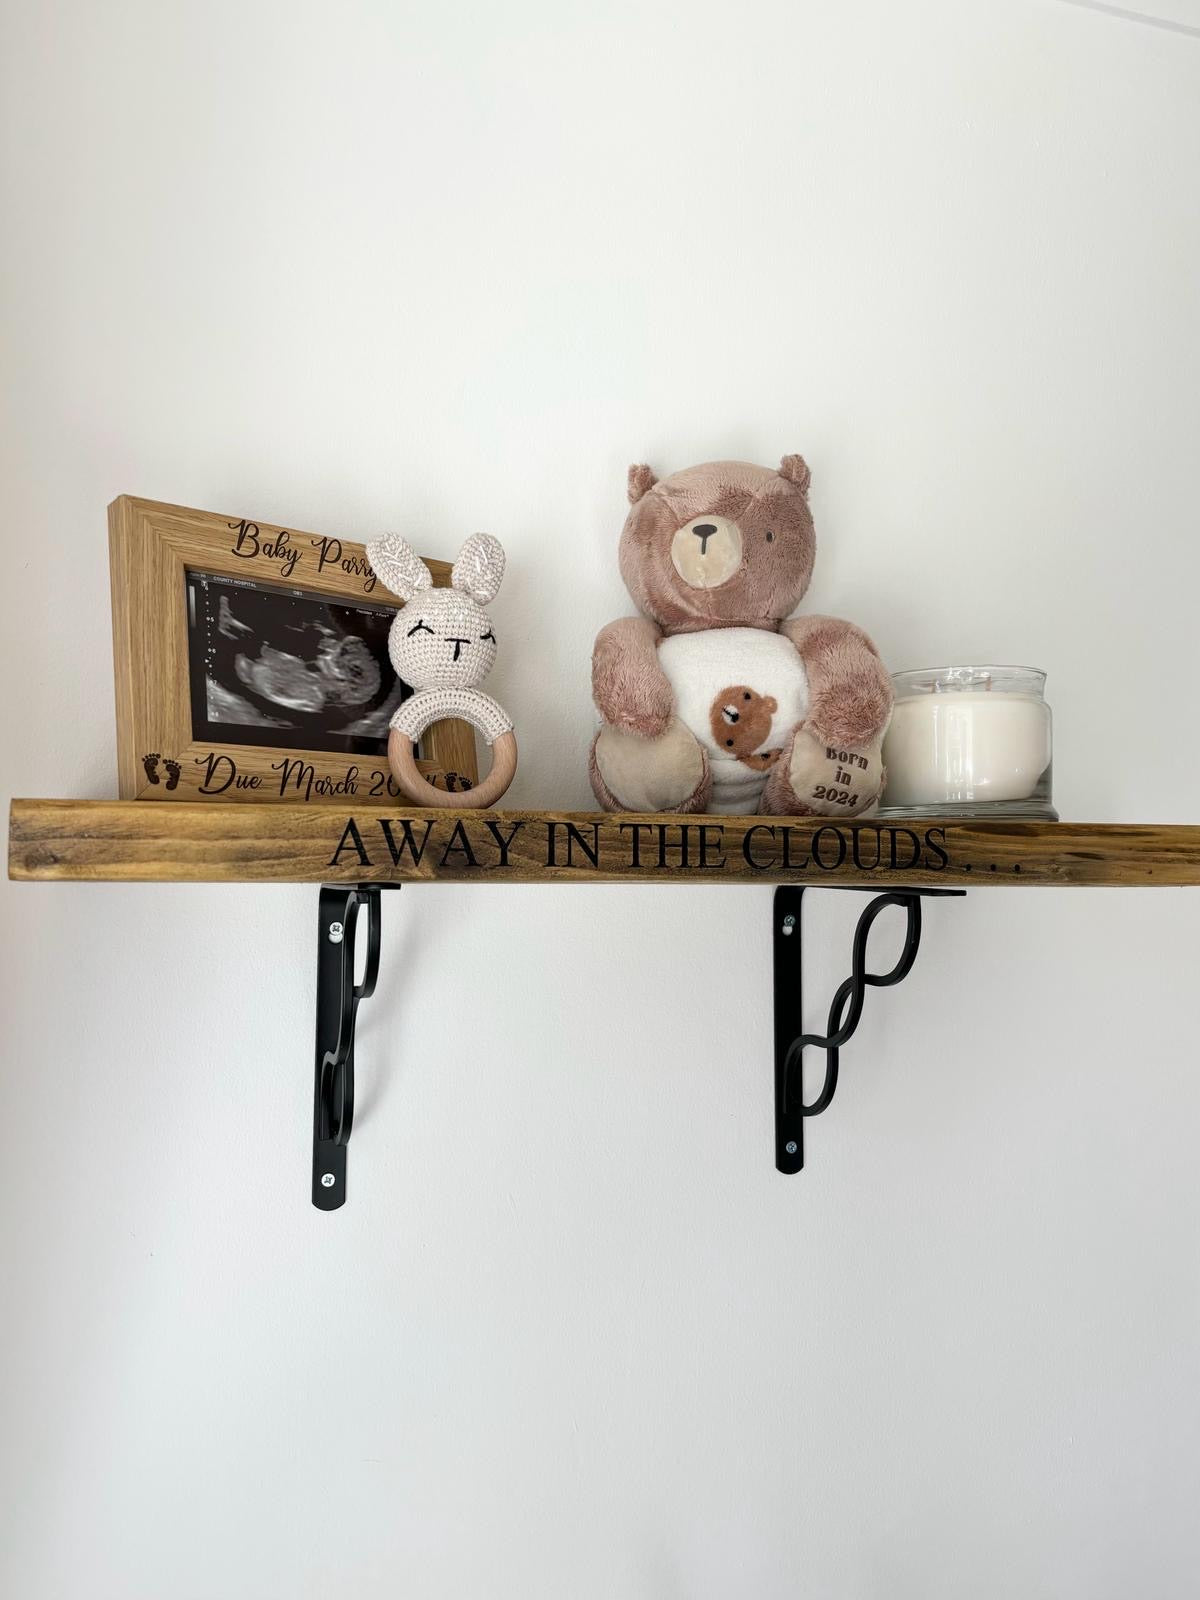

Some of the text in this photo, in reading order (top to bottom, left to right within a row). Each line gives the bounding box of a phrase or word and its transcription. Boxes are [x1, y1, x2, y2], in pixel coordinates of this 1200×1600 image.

[228, 519, 303, 578] Baby
[233, 579, 257, 588] HOSPITAL
[826, 746, 869, 771] Born
[195, 752, 437, 801] Due March 20
[835, 766, 852, 786] in
[812, 785, 859, 807] 2024
[326, 816, 526, 868] AWAY
[543, 821, 604, 868] IN
[618, 822, 727, 869] THE
